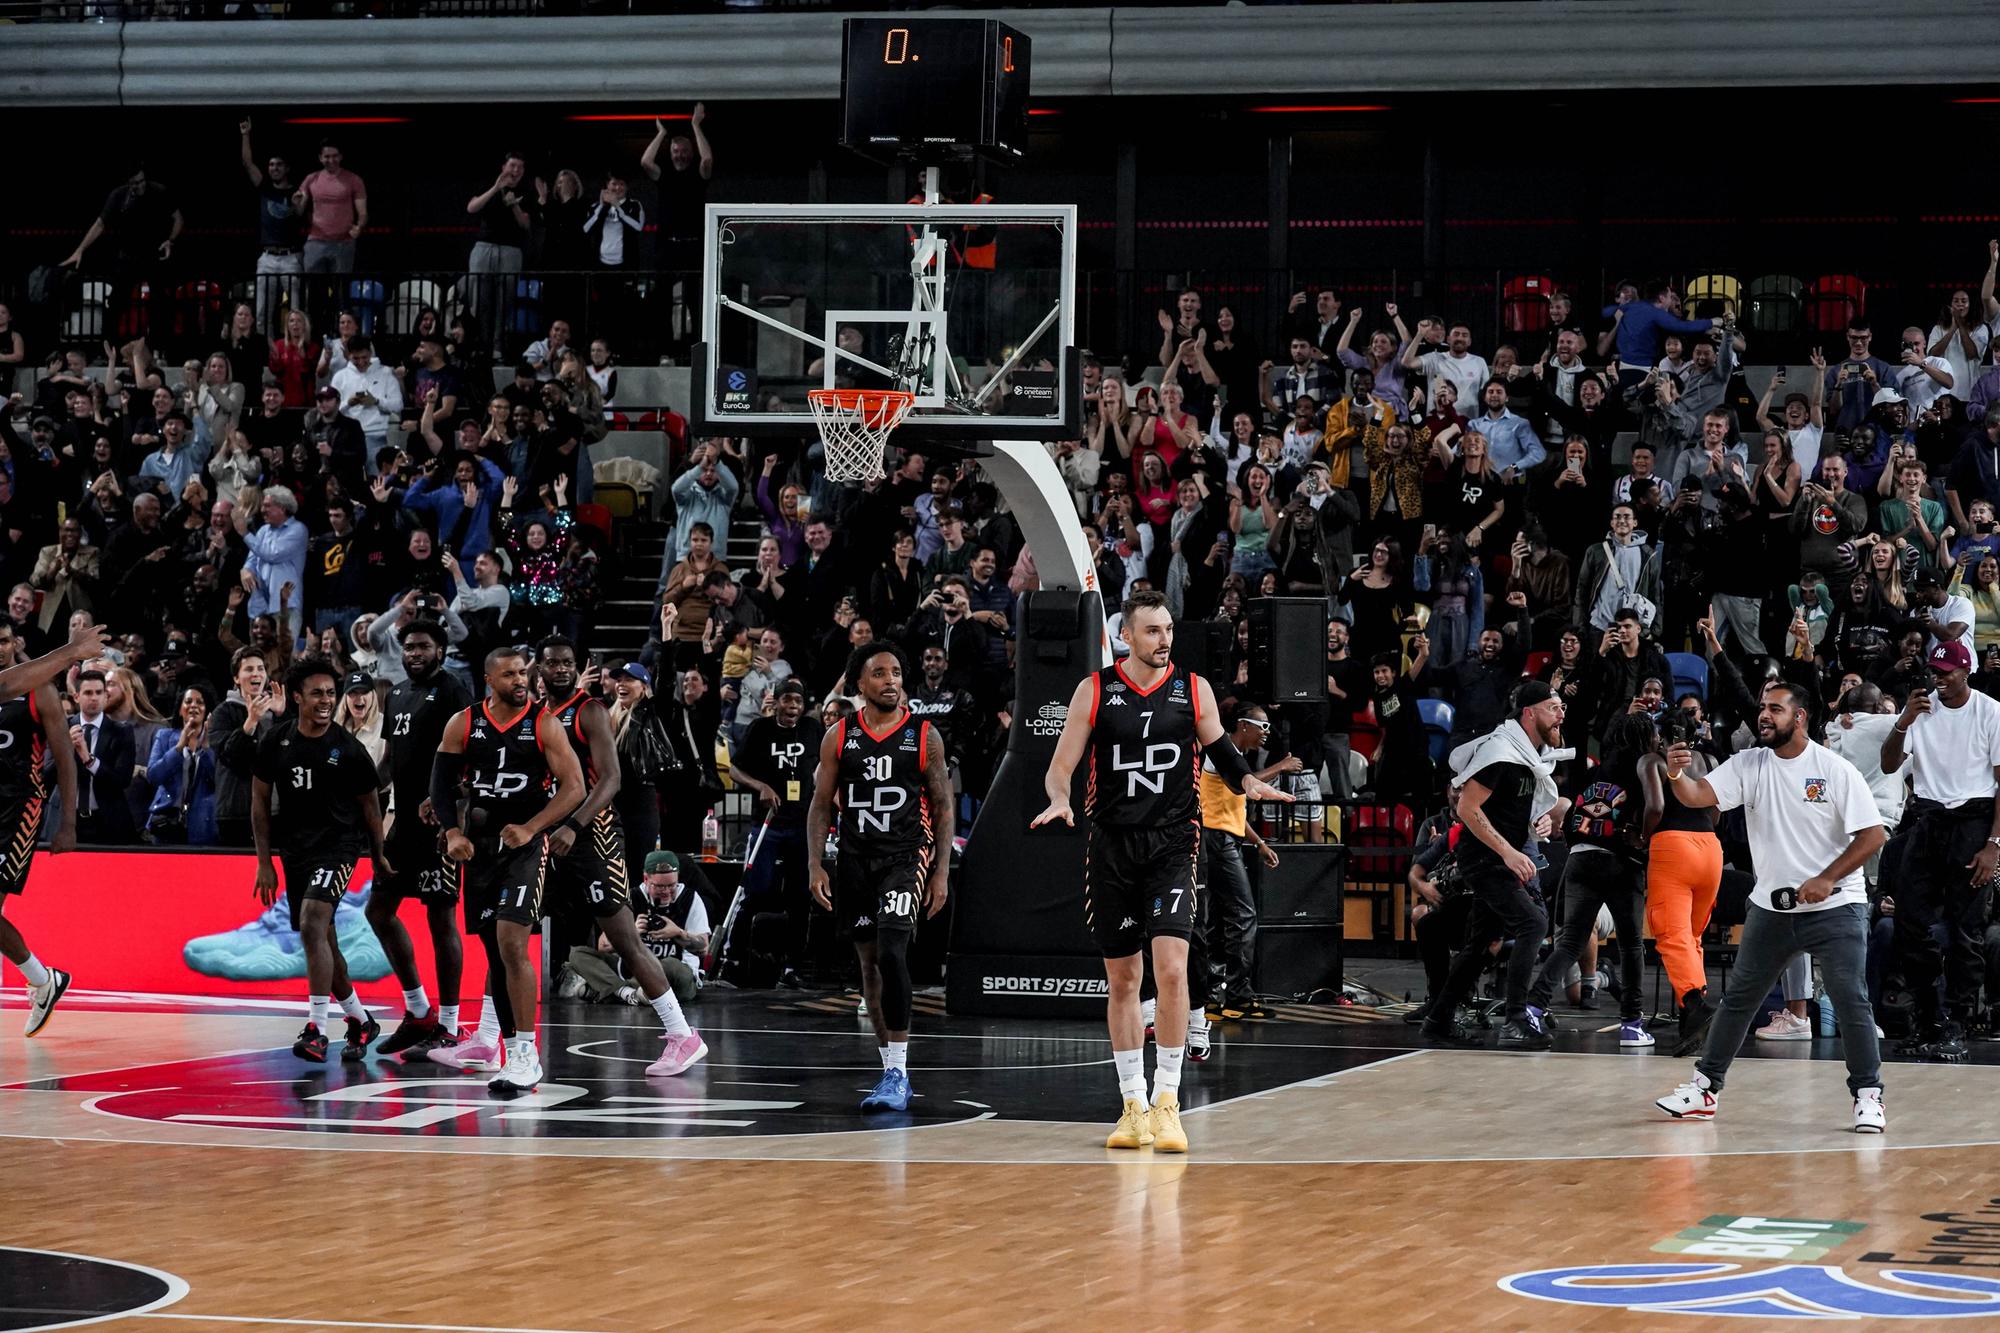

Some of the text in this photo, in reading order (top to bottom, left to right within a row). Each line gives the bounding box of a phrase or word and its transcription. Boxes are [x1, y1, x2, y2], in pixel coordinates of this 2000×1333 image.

[722, 402, 751, 410] EuroCup
[909, 699, 953, 715] Sixers
[393, 713, 412, 735] 23
[1034, 728, 1063, 736] LION
[1139, 711, 1154, 739] 7
[497, 746, 506, 769] 1
[862, 755, 893, 782] 30
[291, 766, 313, 790] 31
[311, 867, 334, 888] 31
[420, 870, 442, 892] 23
[515, 885, 527, 907] 1
[589, 880, 604, 903] 6
[884, 890, 912, 916] 30
[1169, 889, 1184, 913] 7
[1680, 1216, 1833, 1259] BKT
